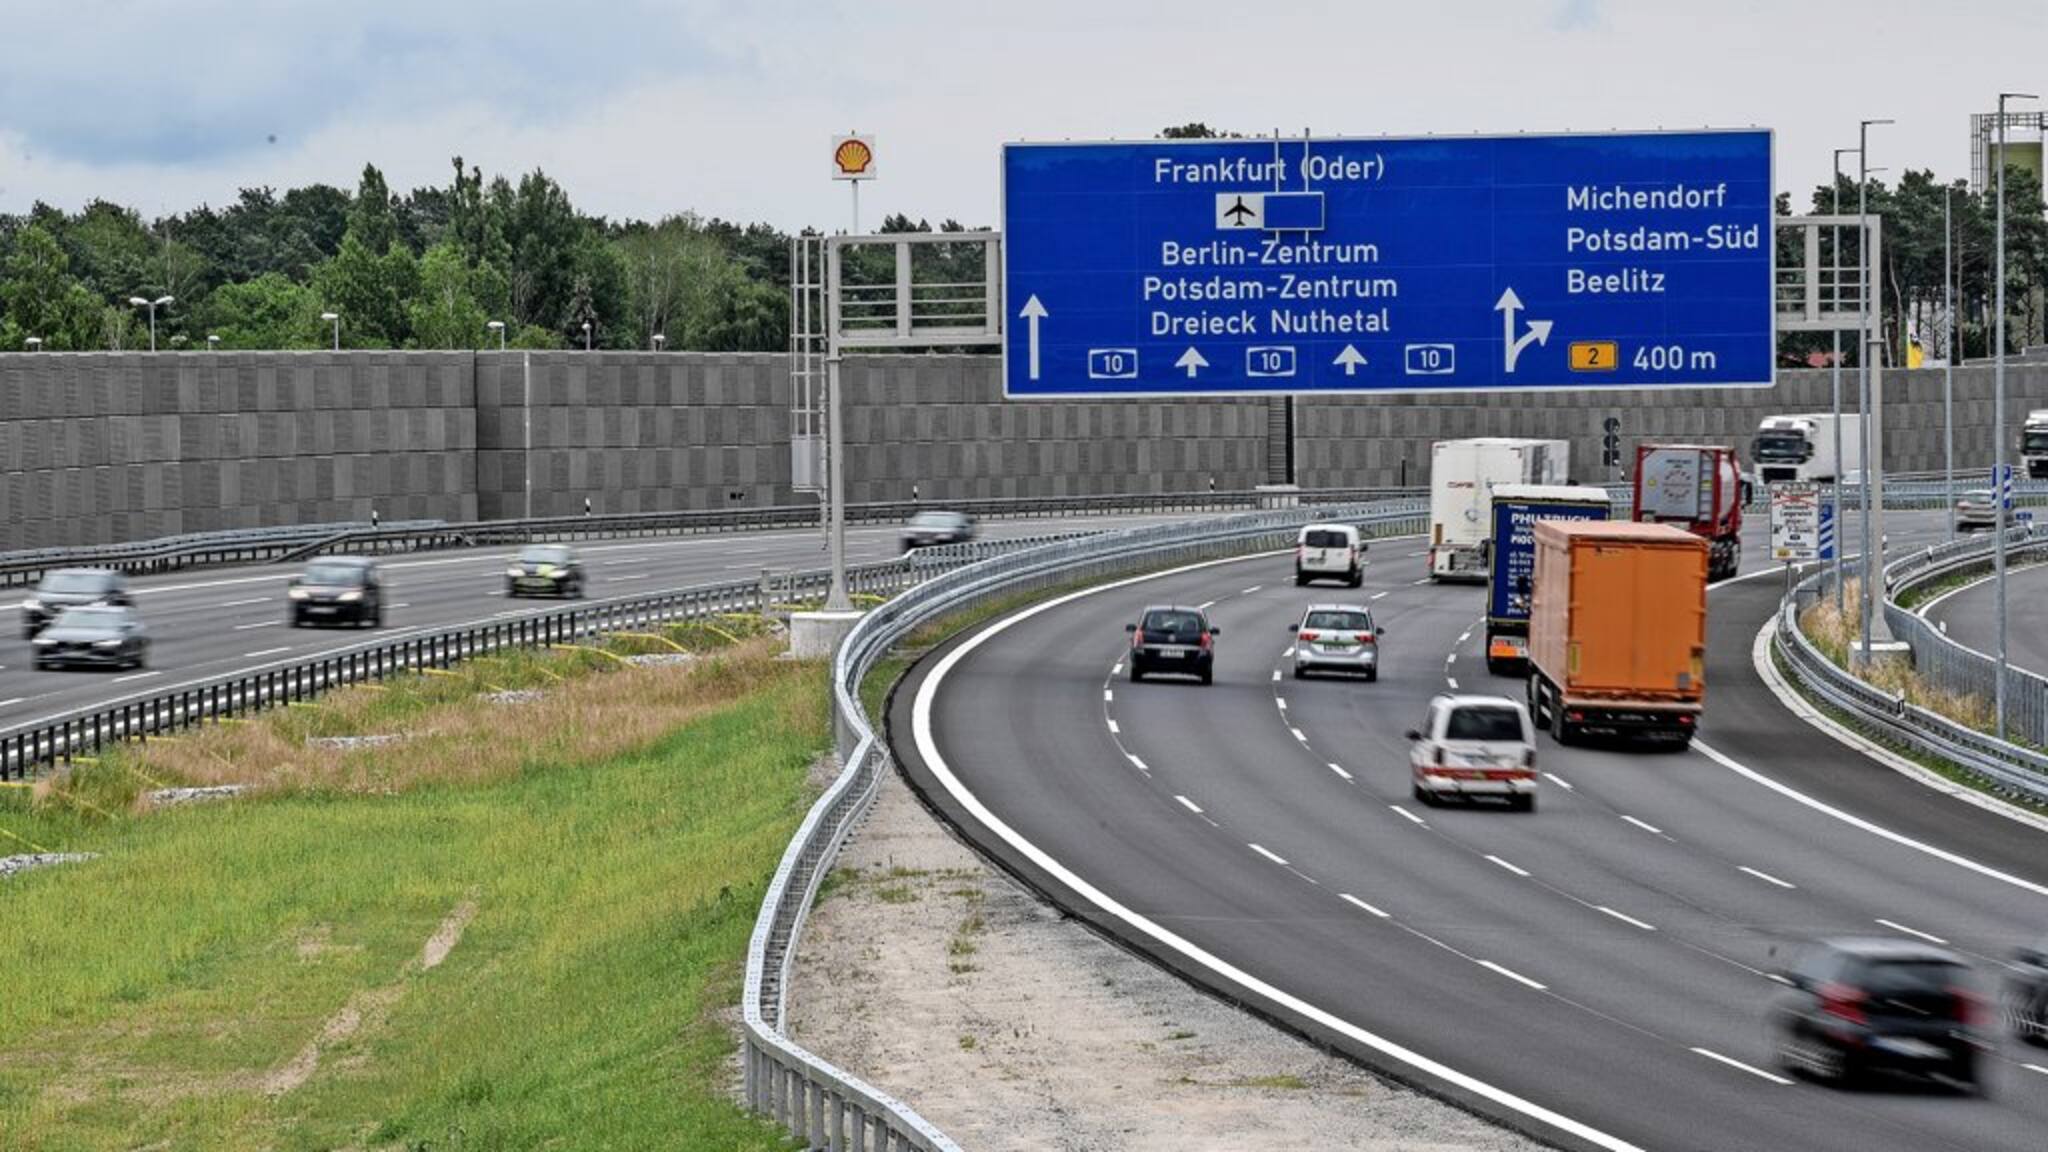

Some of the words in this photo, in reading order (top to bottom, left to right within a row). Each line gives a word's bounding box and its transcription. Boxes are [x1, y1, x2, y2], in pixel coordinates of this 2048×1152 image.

[1155, 157, 1287, 184] Frankfurt
[1300, 153, 1384, 183] (Oder)
[1567, 183, 1727, 211] Michendorf
[1567, 224, 1760, 252] Potsdam-Süd
[1162, 240, 1379, 265] Berlin-Zentrum
[1144, 275, 1398, 301] Potsdam-Zentrum
[1567, 268, 1666, 293] Beelitz
[1151, 310, 1256, 335] Dreieck
[1271, 308, 1390, 333] Nuthetal
[1103, 355, 1123, 373] 10
[1261, 352, 1281, 370] 10
[1420, 350, 1440, 367] 10
[1588, 348, 1599, 365] 2
[1633, 345, 1683, 370] 400
[1691, 351, 1716, 369] m
